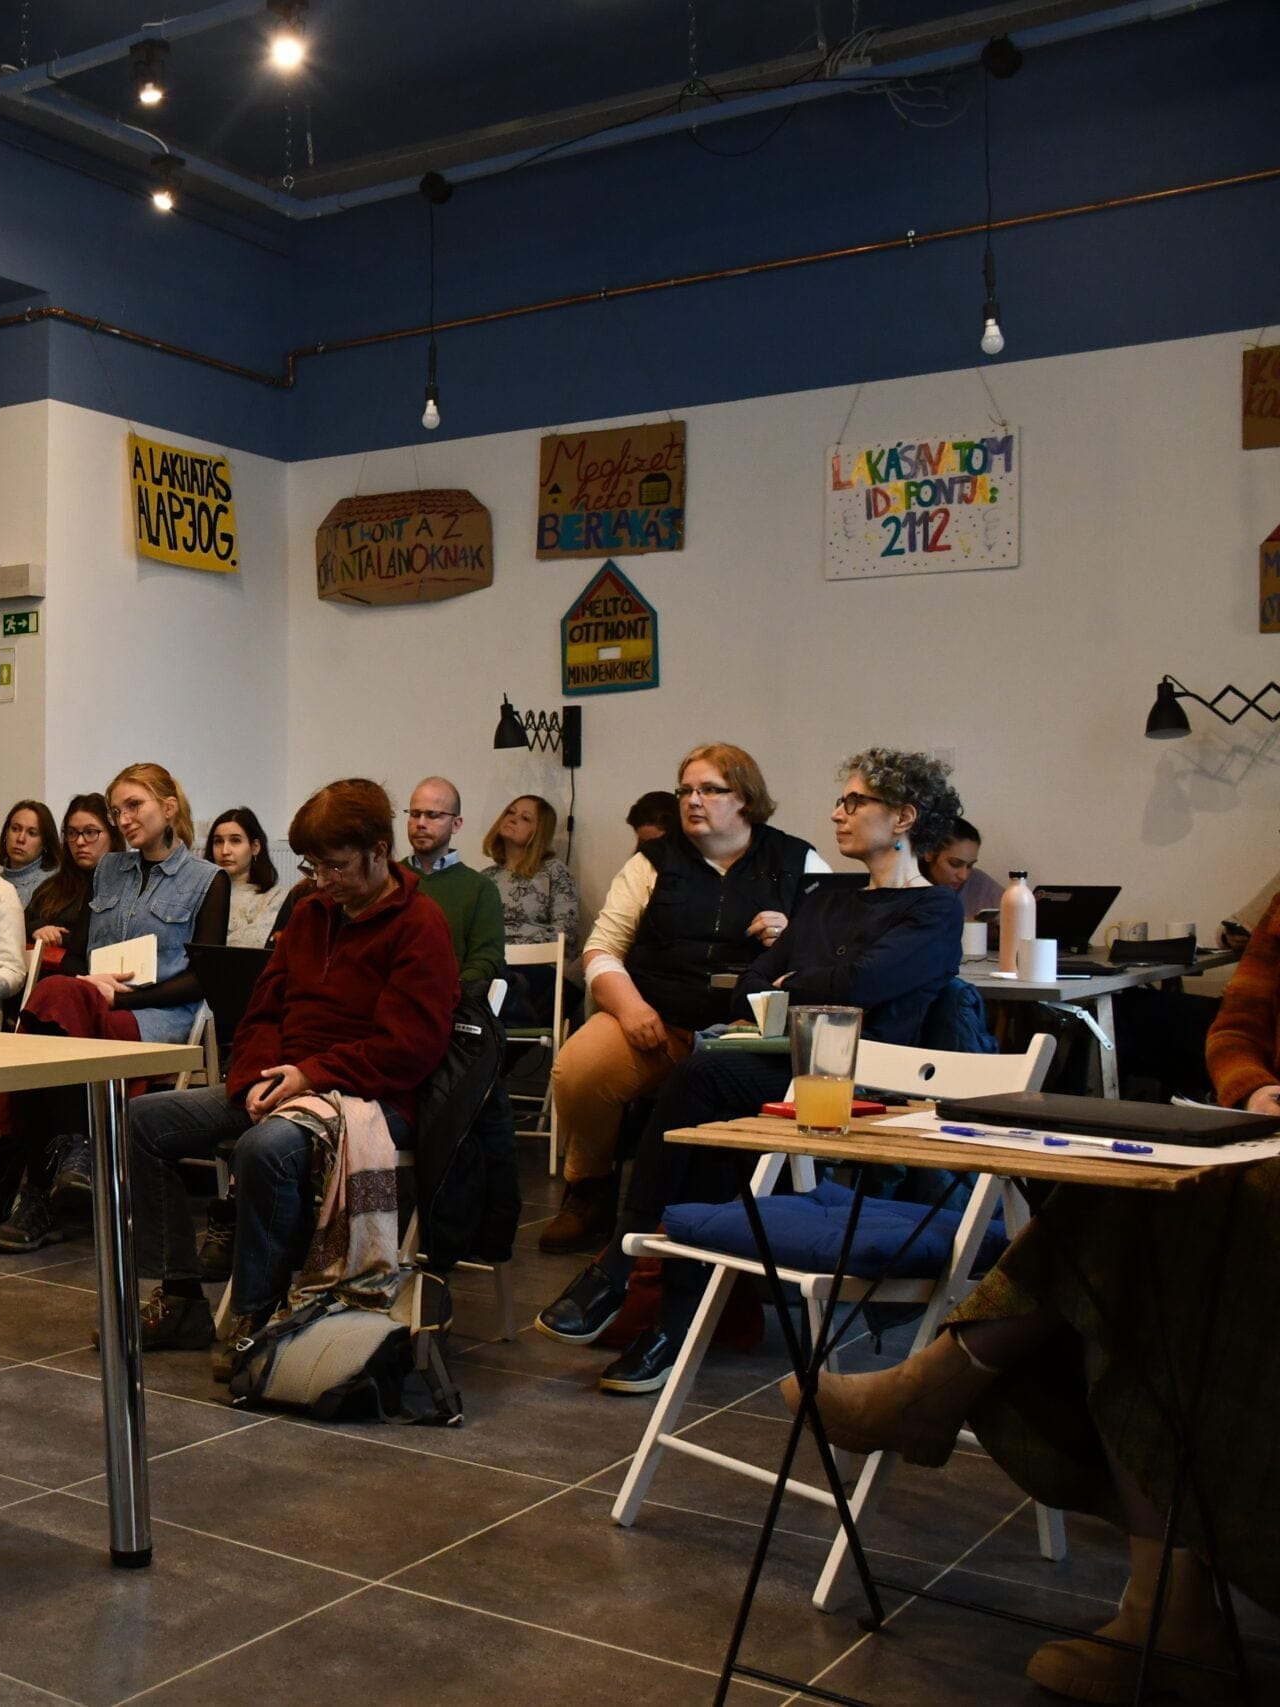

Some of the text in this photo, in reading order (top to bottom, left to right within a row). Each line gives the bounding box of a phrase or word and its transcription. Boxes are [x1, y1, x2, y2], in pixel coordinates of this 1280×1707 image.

[133, 446, 232, 503] A LAKHATÁS
[832, 434, 1014, 491] LAKÁSAVATÓM
[137, 485, 237, 566] ALAPJOG.
[880, 508, 952, 557] 2112
[568, 616, 650, 643] OTTHONT
[567, 659, 651, 686] MINDENKINEK
